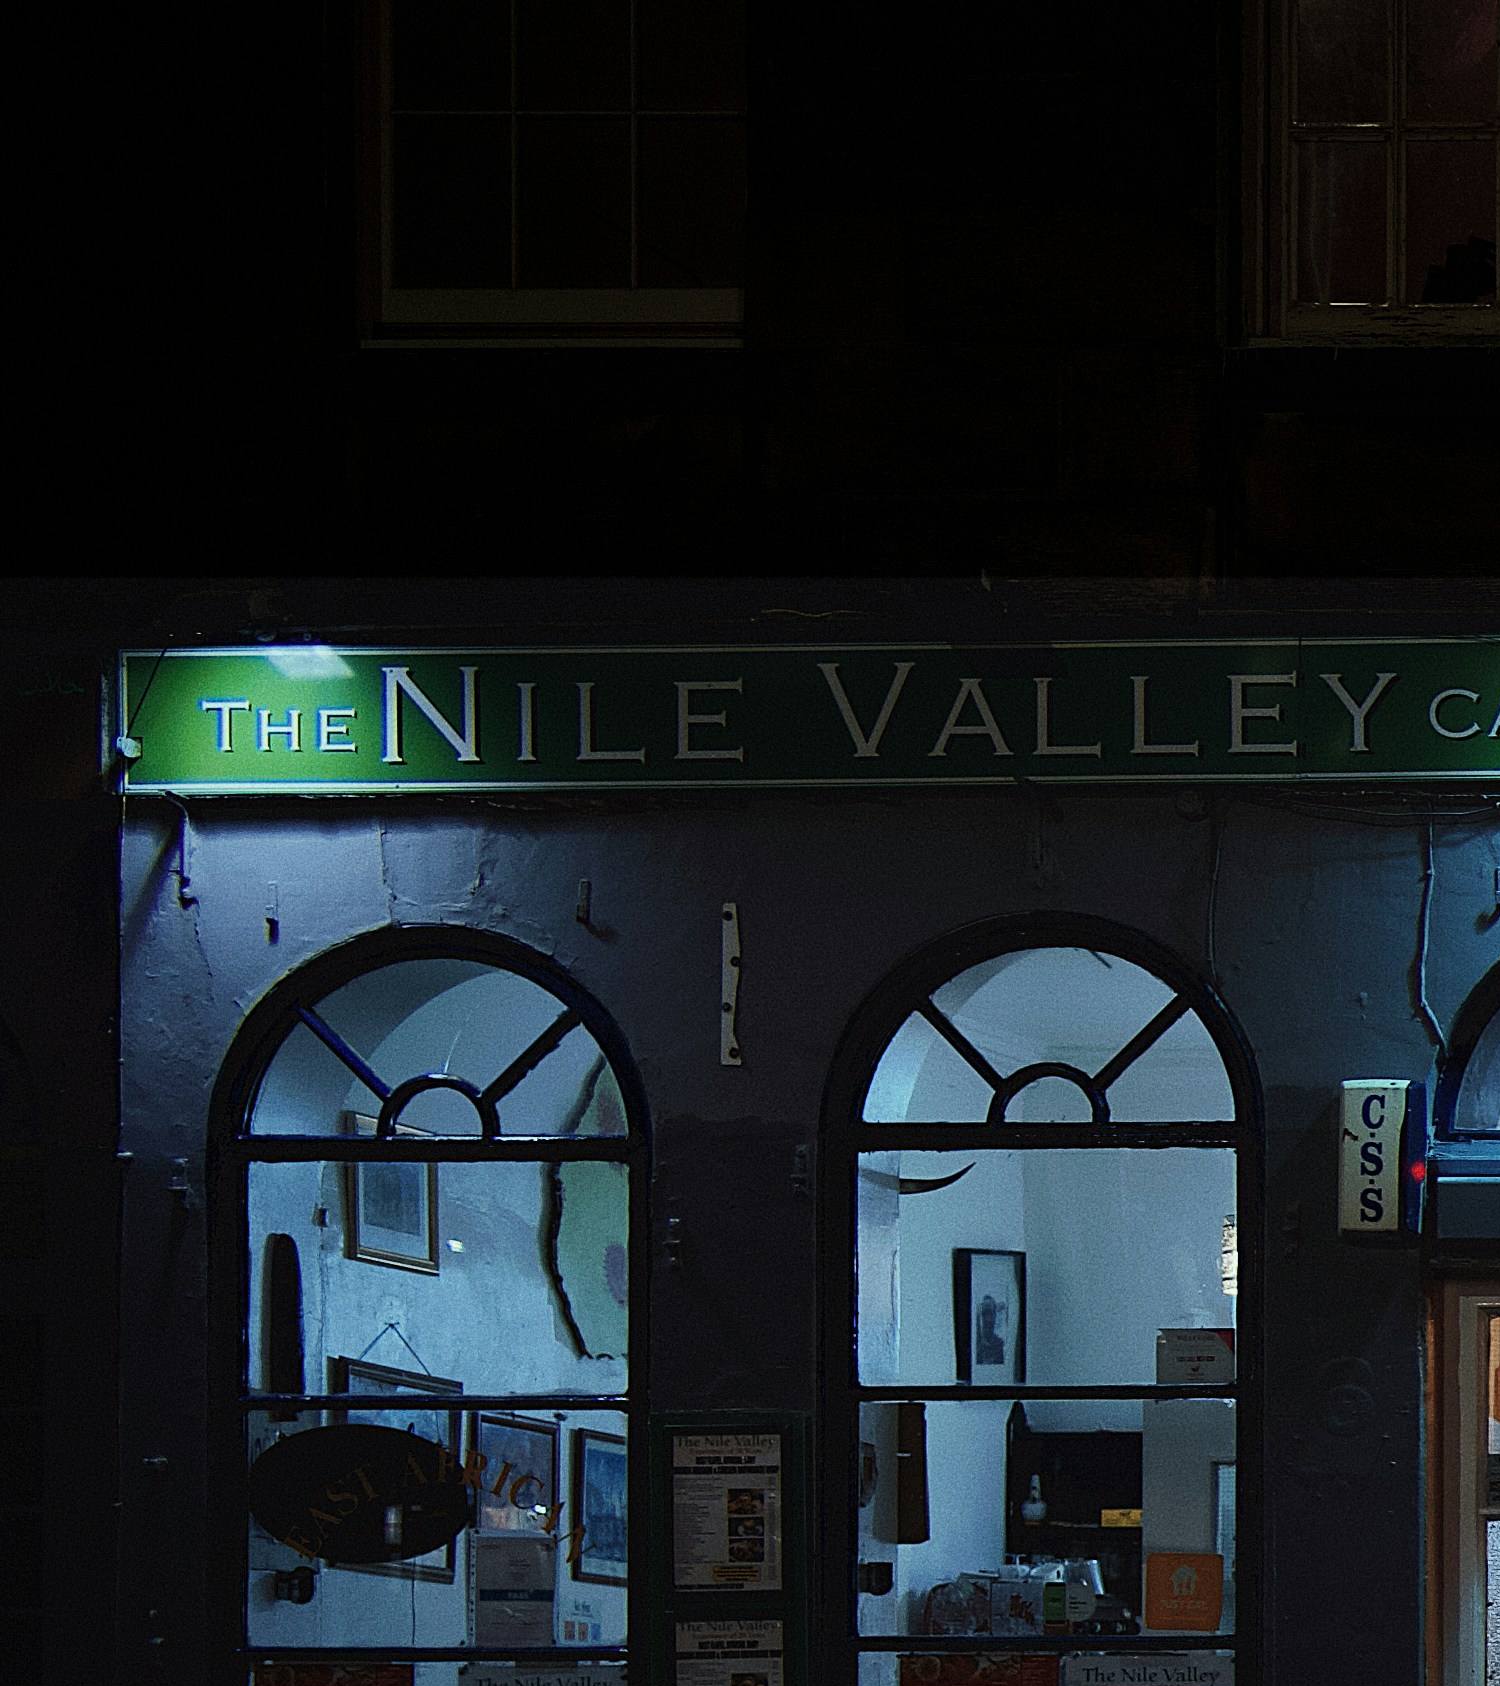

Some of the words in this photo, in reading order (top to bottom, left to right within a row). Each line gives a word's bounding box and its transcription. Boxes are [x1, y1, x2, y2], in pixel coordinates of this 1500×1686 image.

[200, 698, 359, 754] THE
[380, 664, 747, 765] NILE
[816, 660, 1397, 761] VALLEY
[281, 1462, 380, 1567] EAST
[1082, 1667, 1116, 1683] The
[1121, 1667, 1157, 1683] Nile
[1163, 1667, 1220, 1686] Valley
